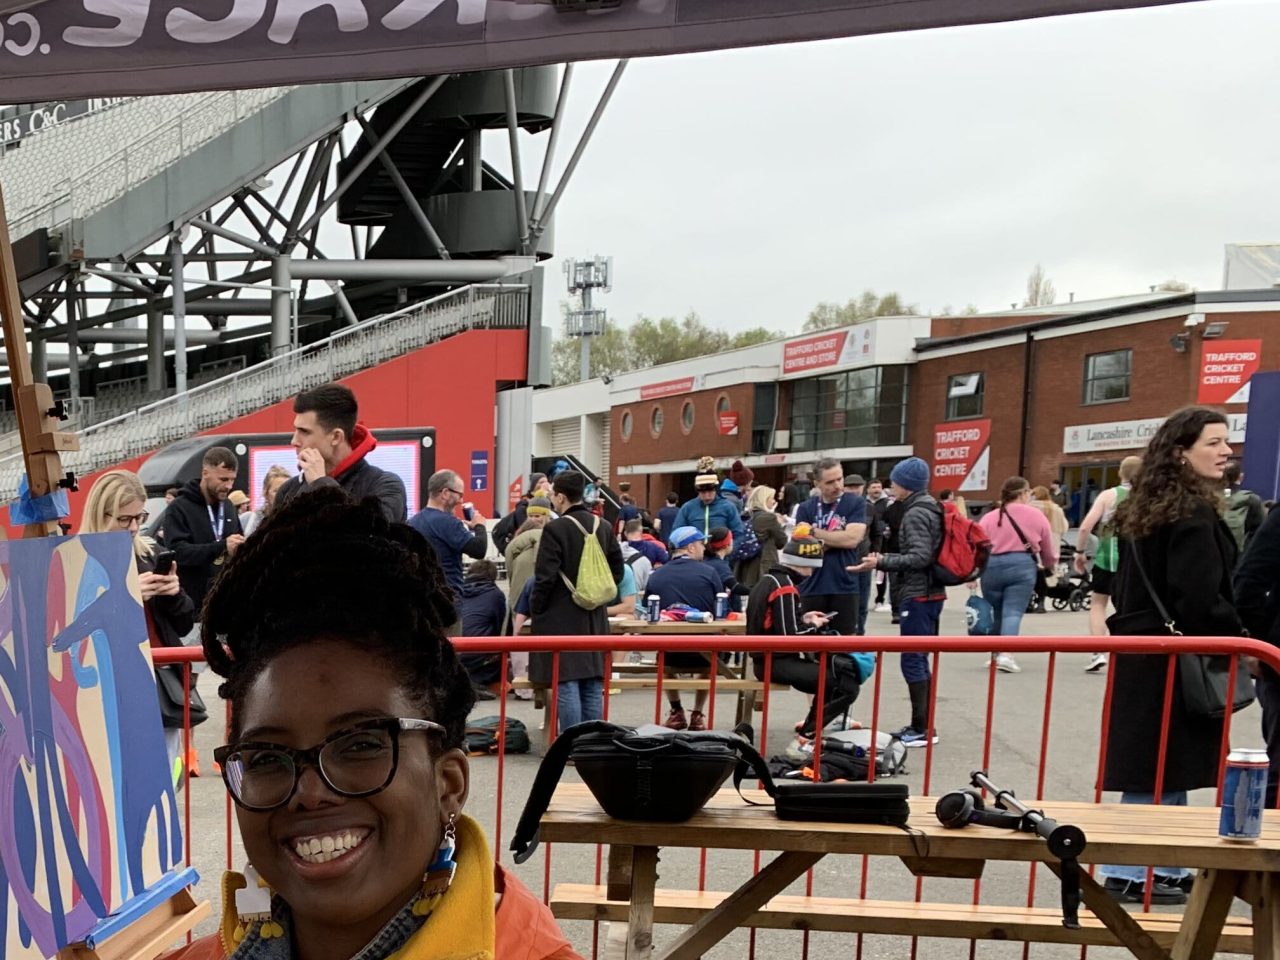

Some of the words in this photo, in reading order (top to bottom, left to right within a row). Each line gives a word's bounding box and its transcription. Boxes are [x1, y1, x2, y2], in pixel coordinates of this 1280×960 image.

[1205, 352, 1257, 362] TRAFFORD
[1204, 363, 1246, 374] CRICKET
[1203, 374, 1242, 385] CENTRE
[936, 428, 981, 443] TRAFFORD
[1086, 426, 1133, 441] Lancashire
[935, 446, 970, 461] CRICKET
[934, 463, 967, 477] CENTRE
